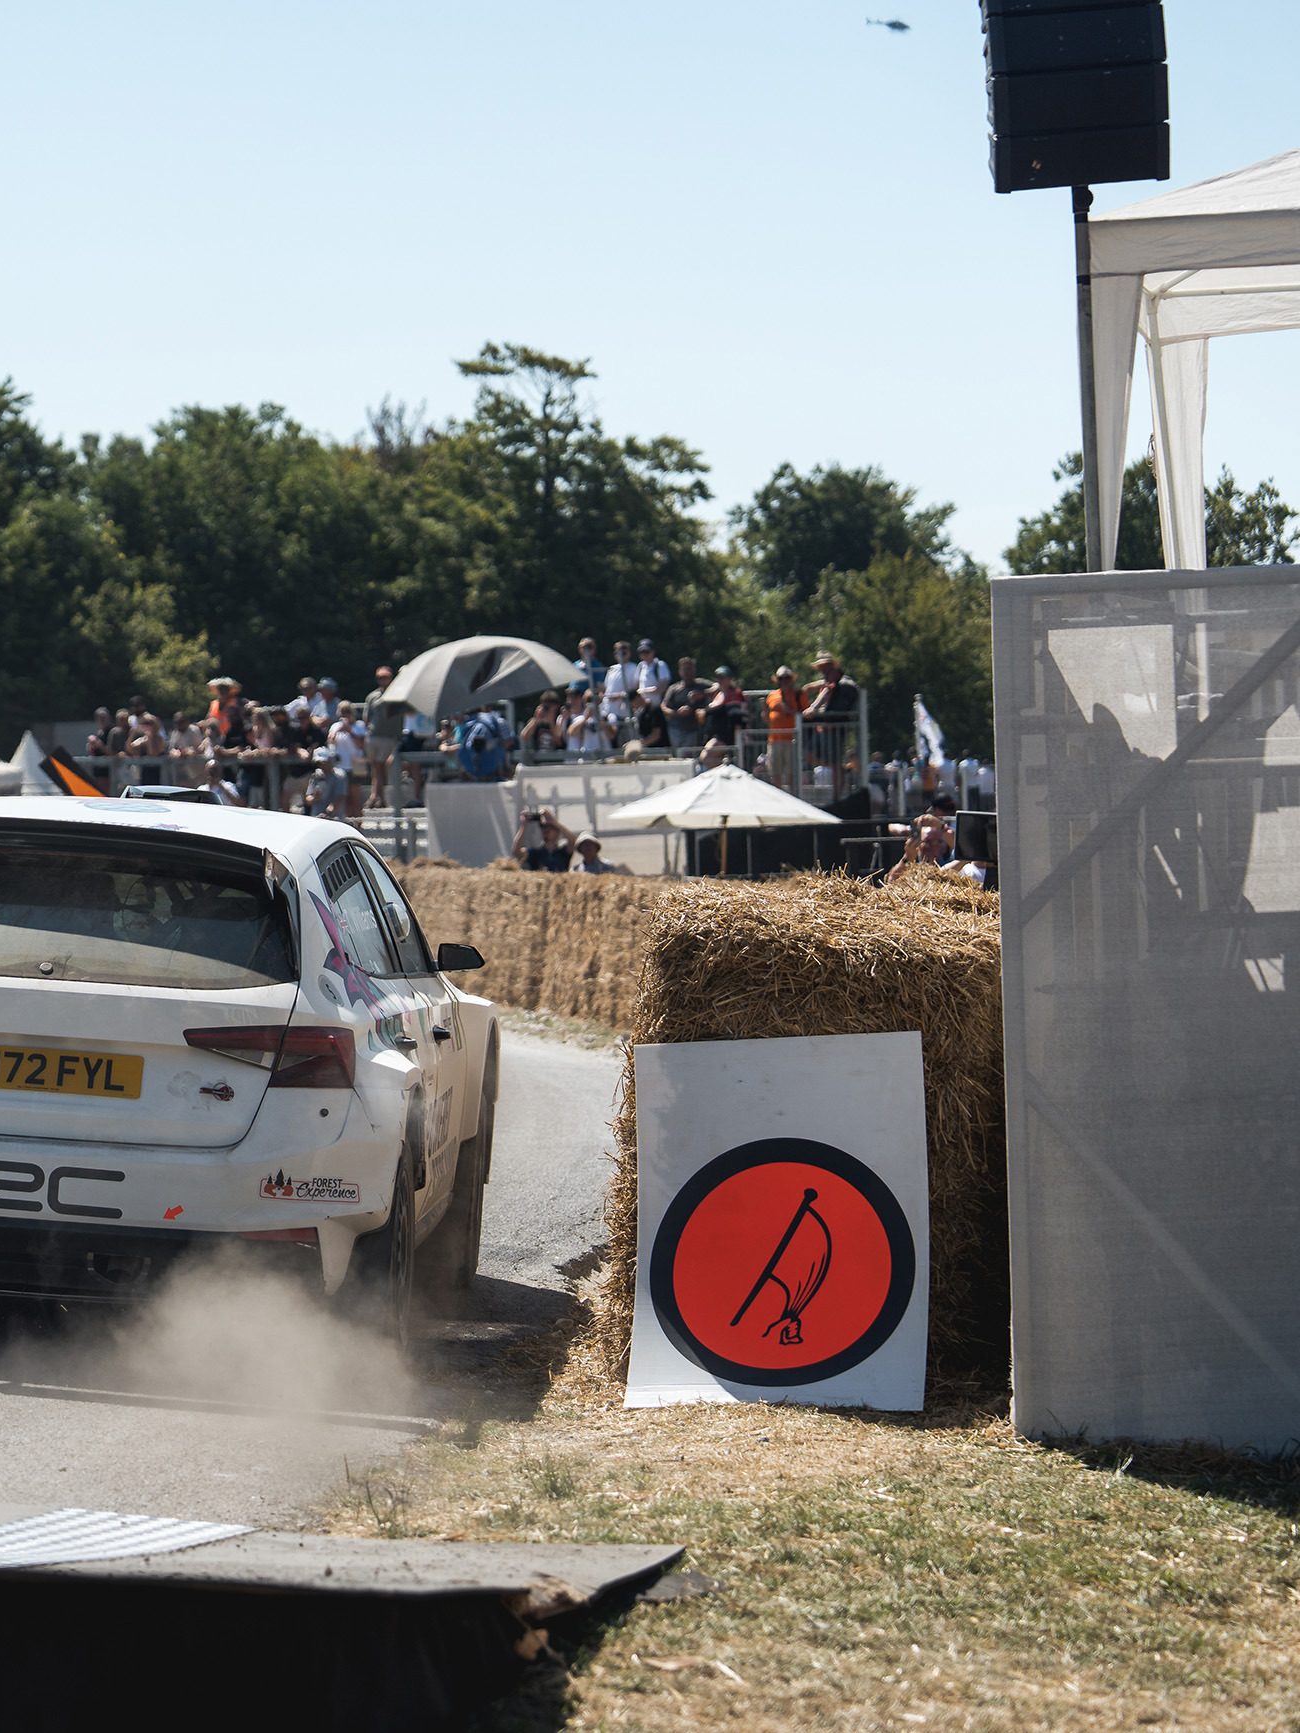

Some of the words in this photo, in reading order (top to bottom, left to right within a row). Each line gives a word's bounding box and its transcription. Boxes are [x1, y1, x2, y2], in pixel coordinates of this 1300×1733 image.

[56, 1055, 125, 1092] FYL
[296, 1182, 358, 1200] Experience
[311, 1177, 343, 1189] FOREST
